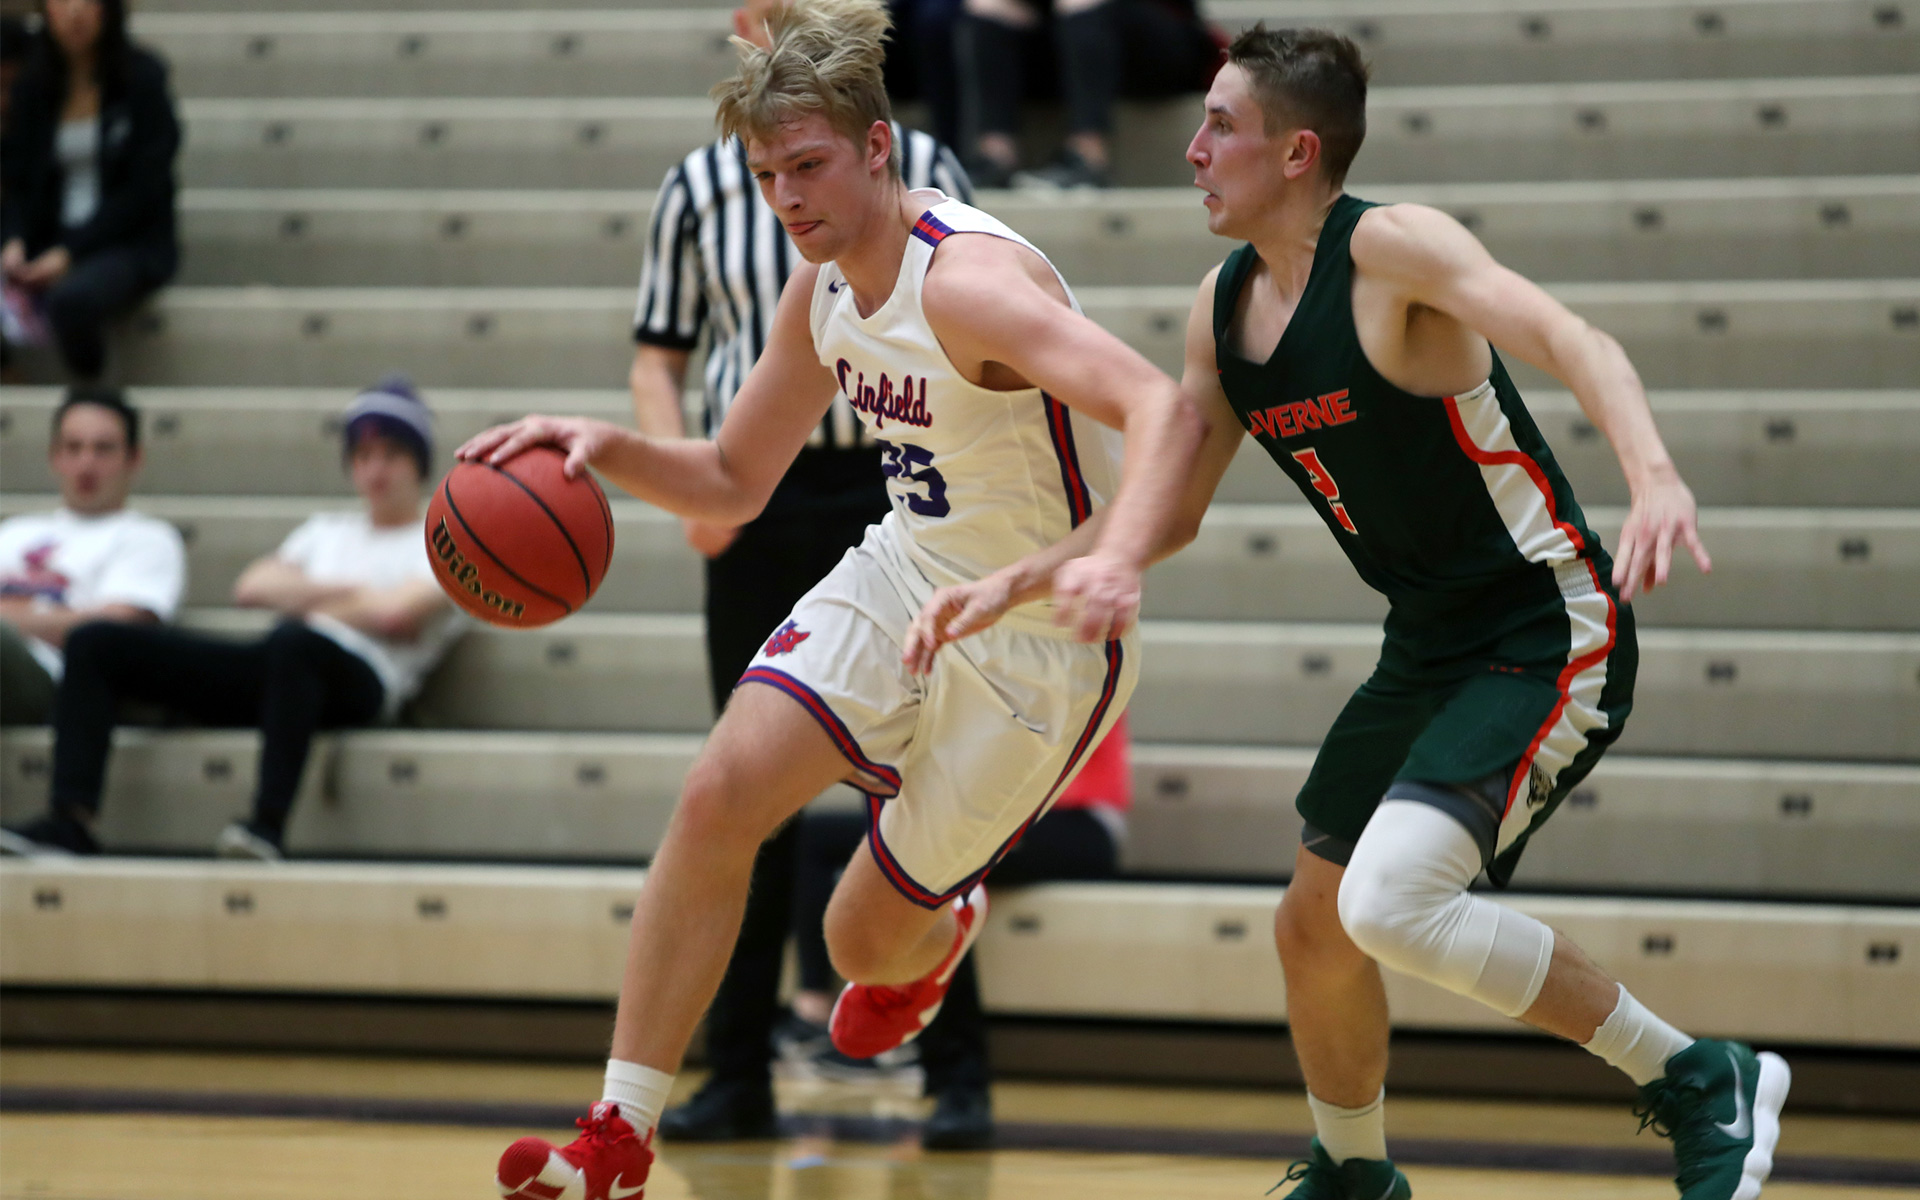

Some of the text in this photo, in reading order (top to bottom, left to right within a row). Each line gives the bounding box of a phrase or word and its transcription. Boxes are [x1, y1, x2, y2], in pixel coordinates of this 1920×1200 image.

[836, 357, 932, 429] Linfield
[1291, 446, 1359, 535] 2
[432, 514, 526, 619] Wilson
